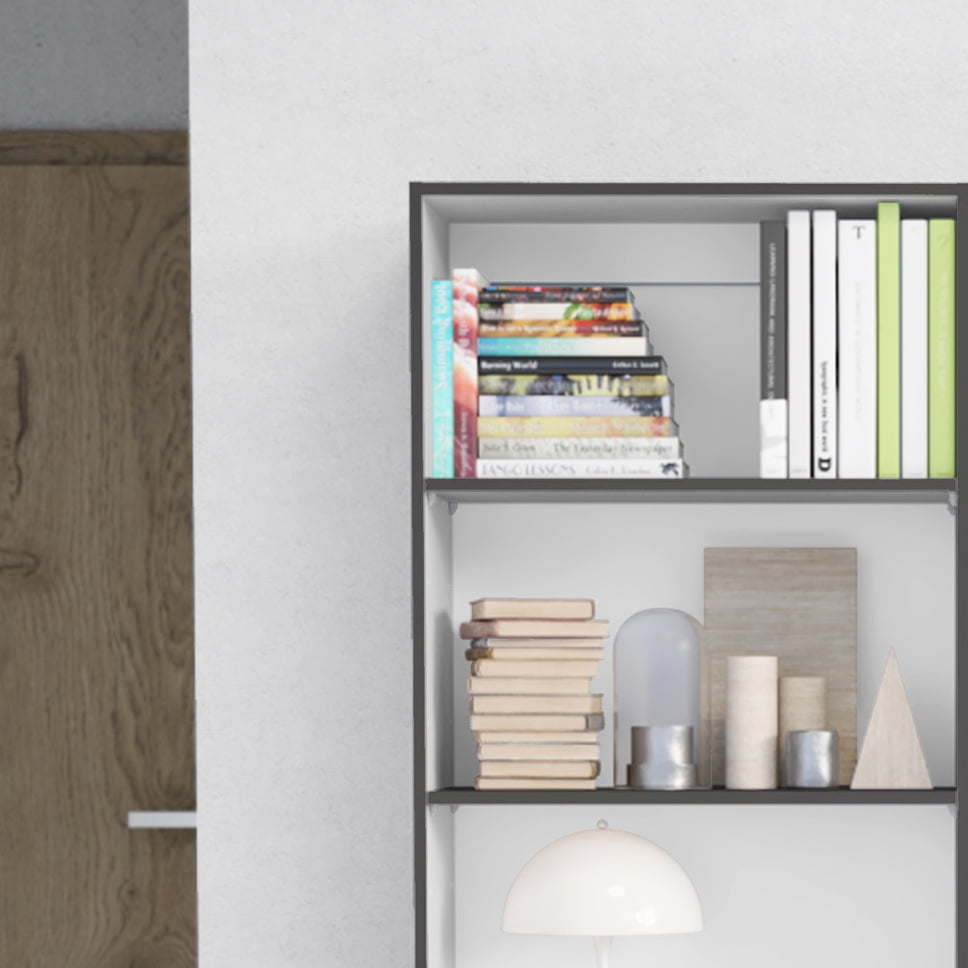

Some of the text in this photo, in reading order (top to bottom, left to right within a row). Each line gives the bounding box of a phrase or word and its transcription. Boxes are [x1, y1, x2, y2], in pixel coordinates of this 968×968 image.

[513, 361, 538, 370] World
[525, 464, 577, 476] LESSONS
[818, 458, 832, 473] D
